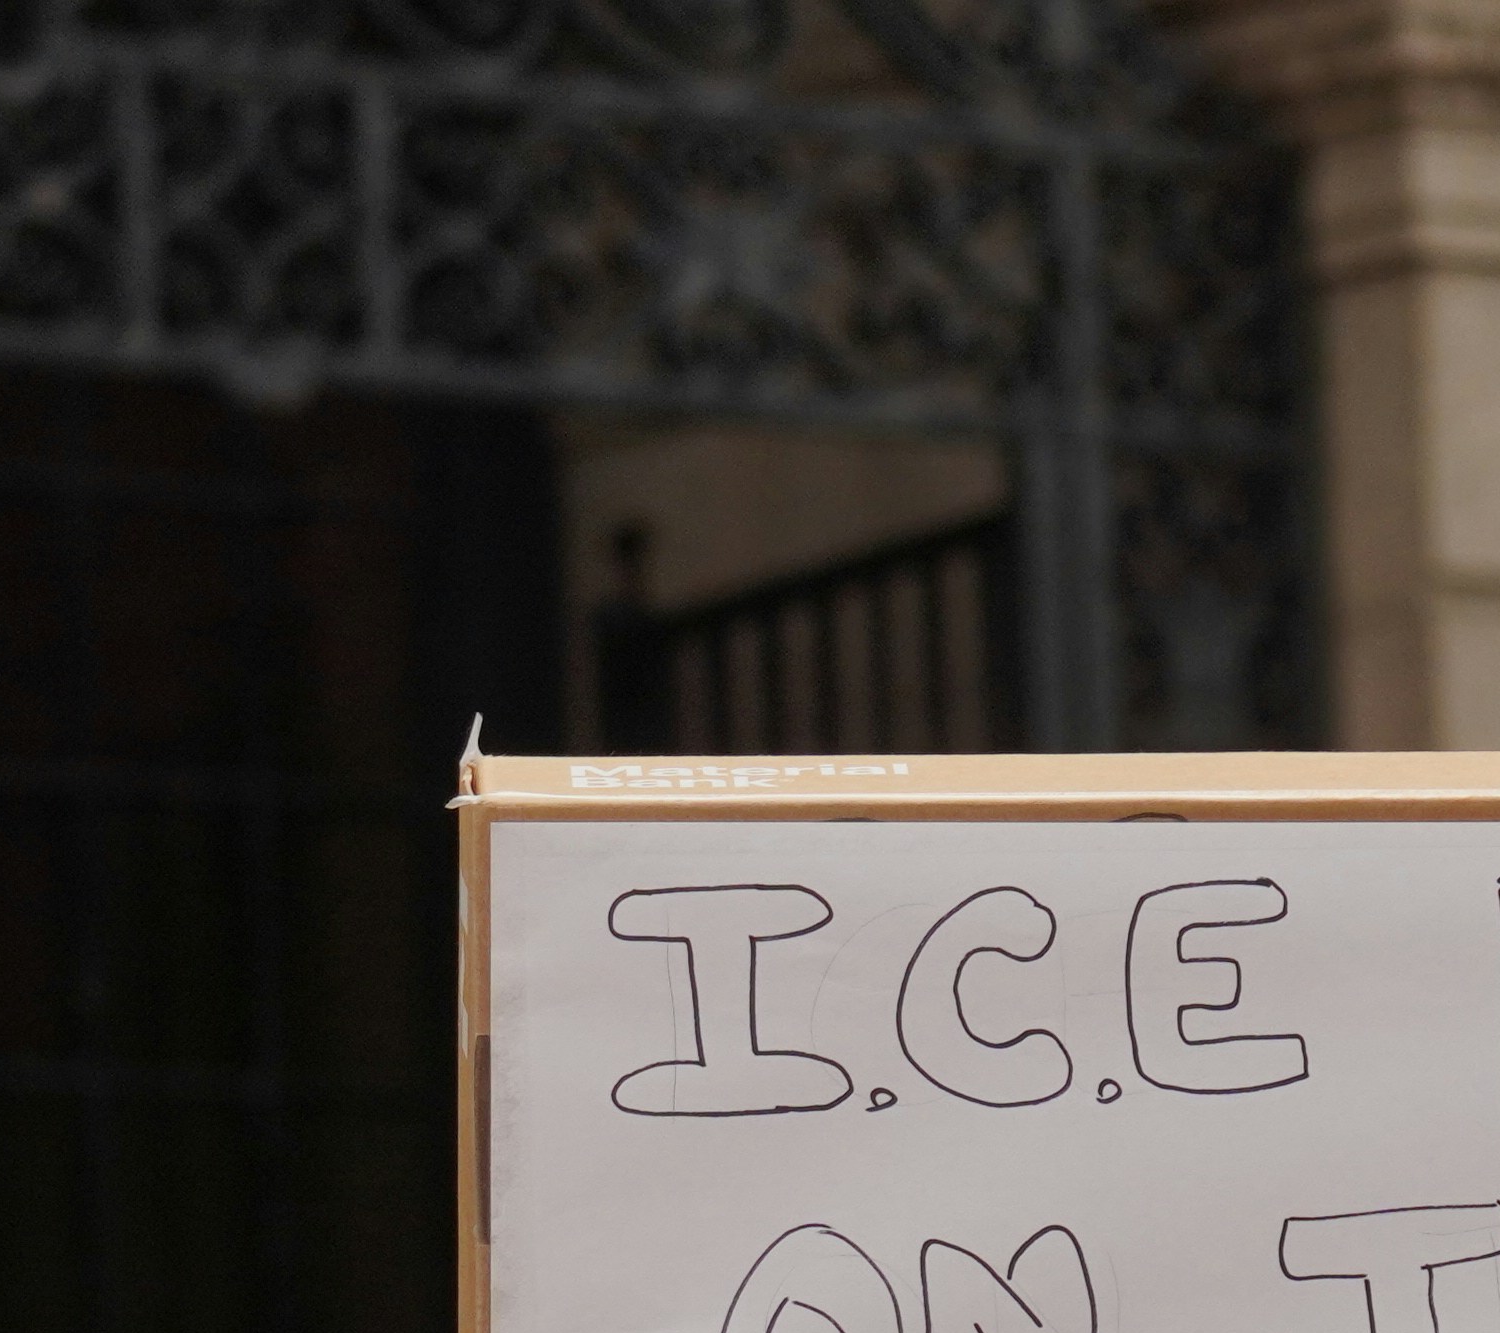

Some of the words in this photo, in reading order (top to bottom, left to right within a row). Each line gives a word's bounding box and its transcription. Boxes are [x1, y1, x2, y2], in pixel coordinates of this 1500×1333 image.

[569, 762, 909, 777] Material
[570, 776, 779, 789] Bank
[608, 877, 1308, 1116] I.C.E
